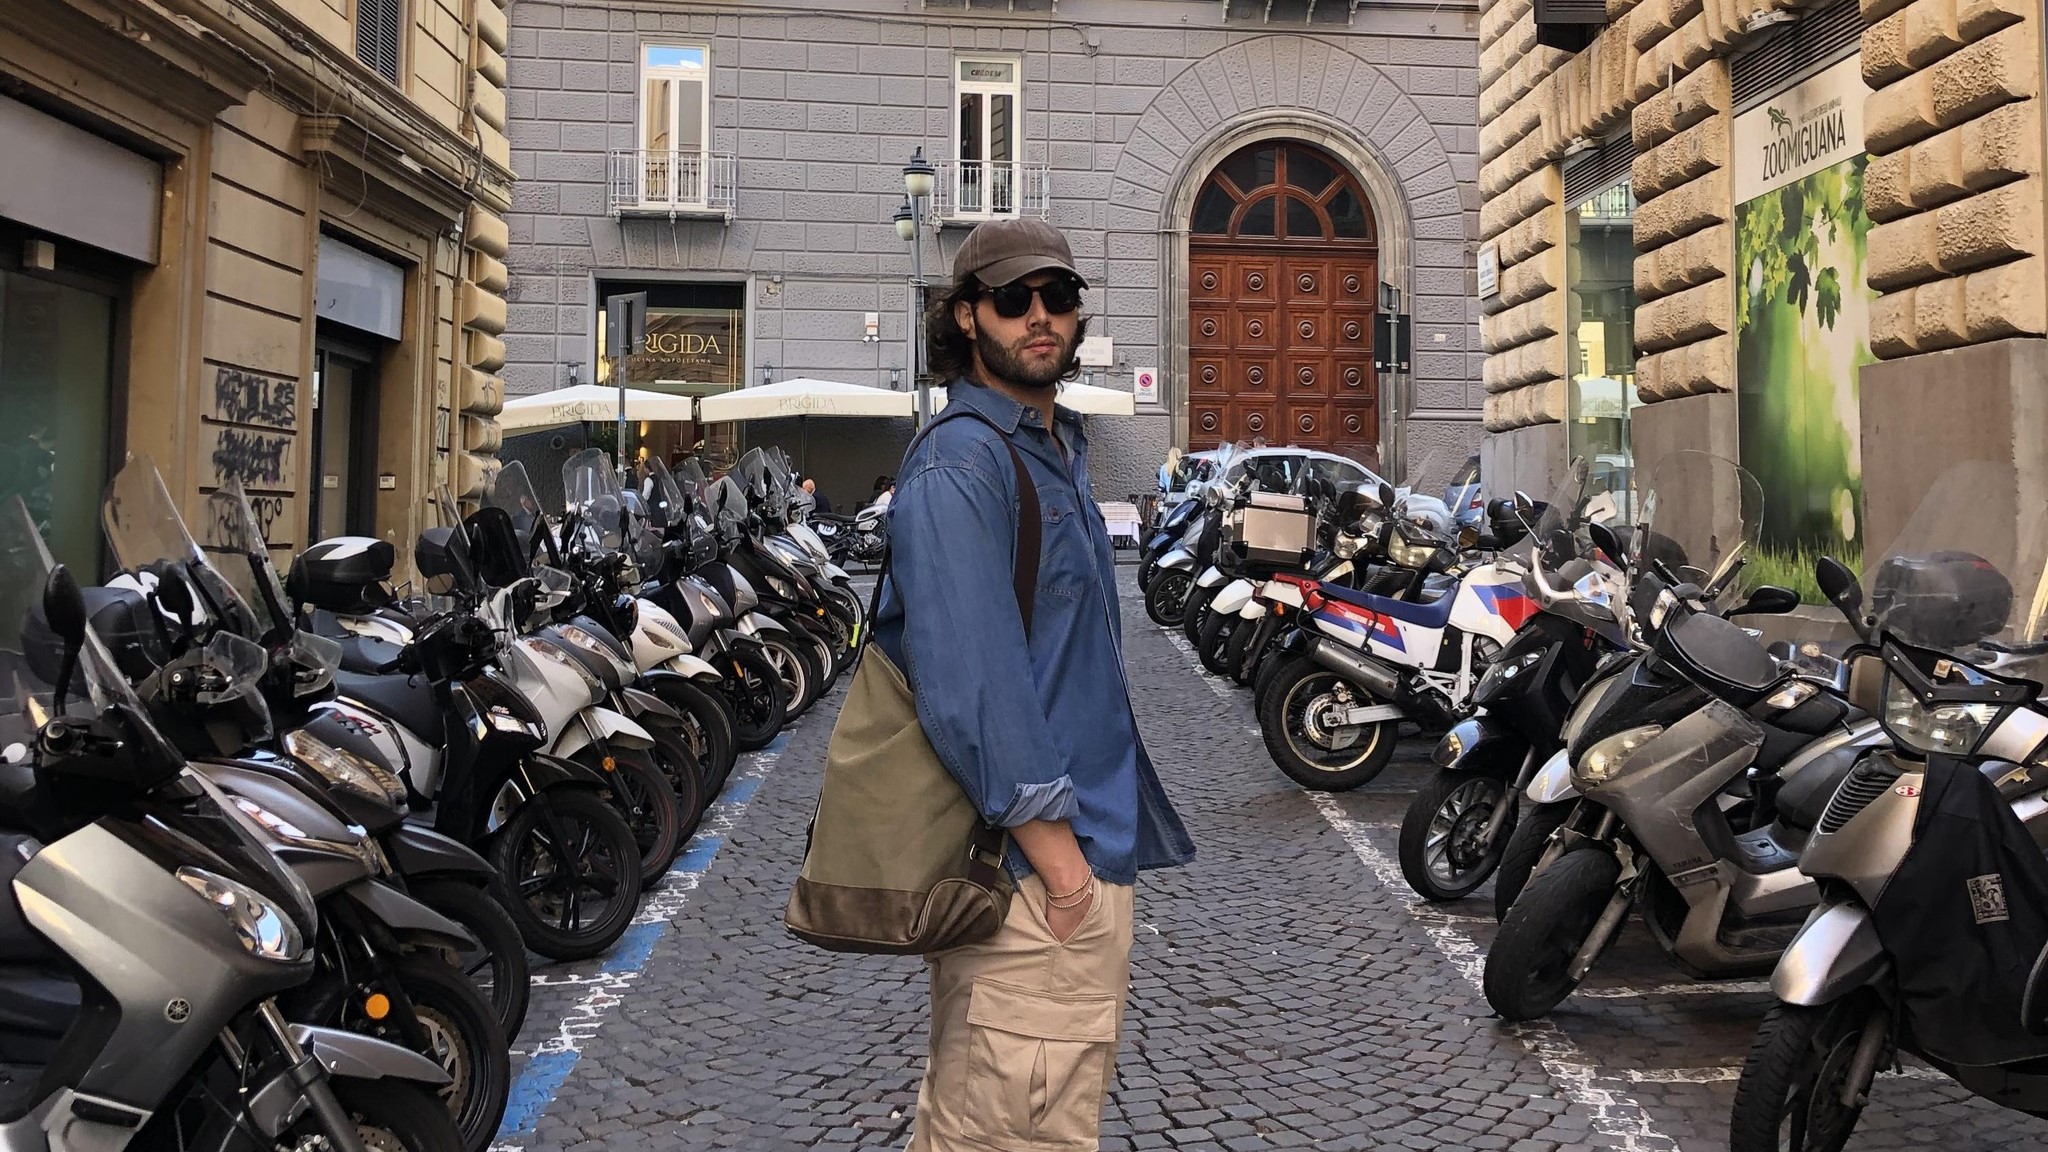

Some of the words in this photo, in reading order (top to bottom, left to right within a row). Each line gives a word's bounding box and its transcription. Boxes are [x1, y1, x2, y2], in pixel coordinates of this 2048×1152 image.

[1763, 109, 1846, 182] ZOOMIGUANA
[551, 402, 611, 419] BRIGIDA
[779, 395, 836, 411] BRIGIDA
